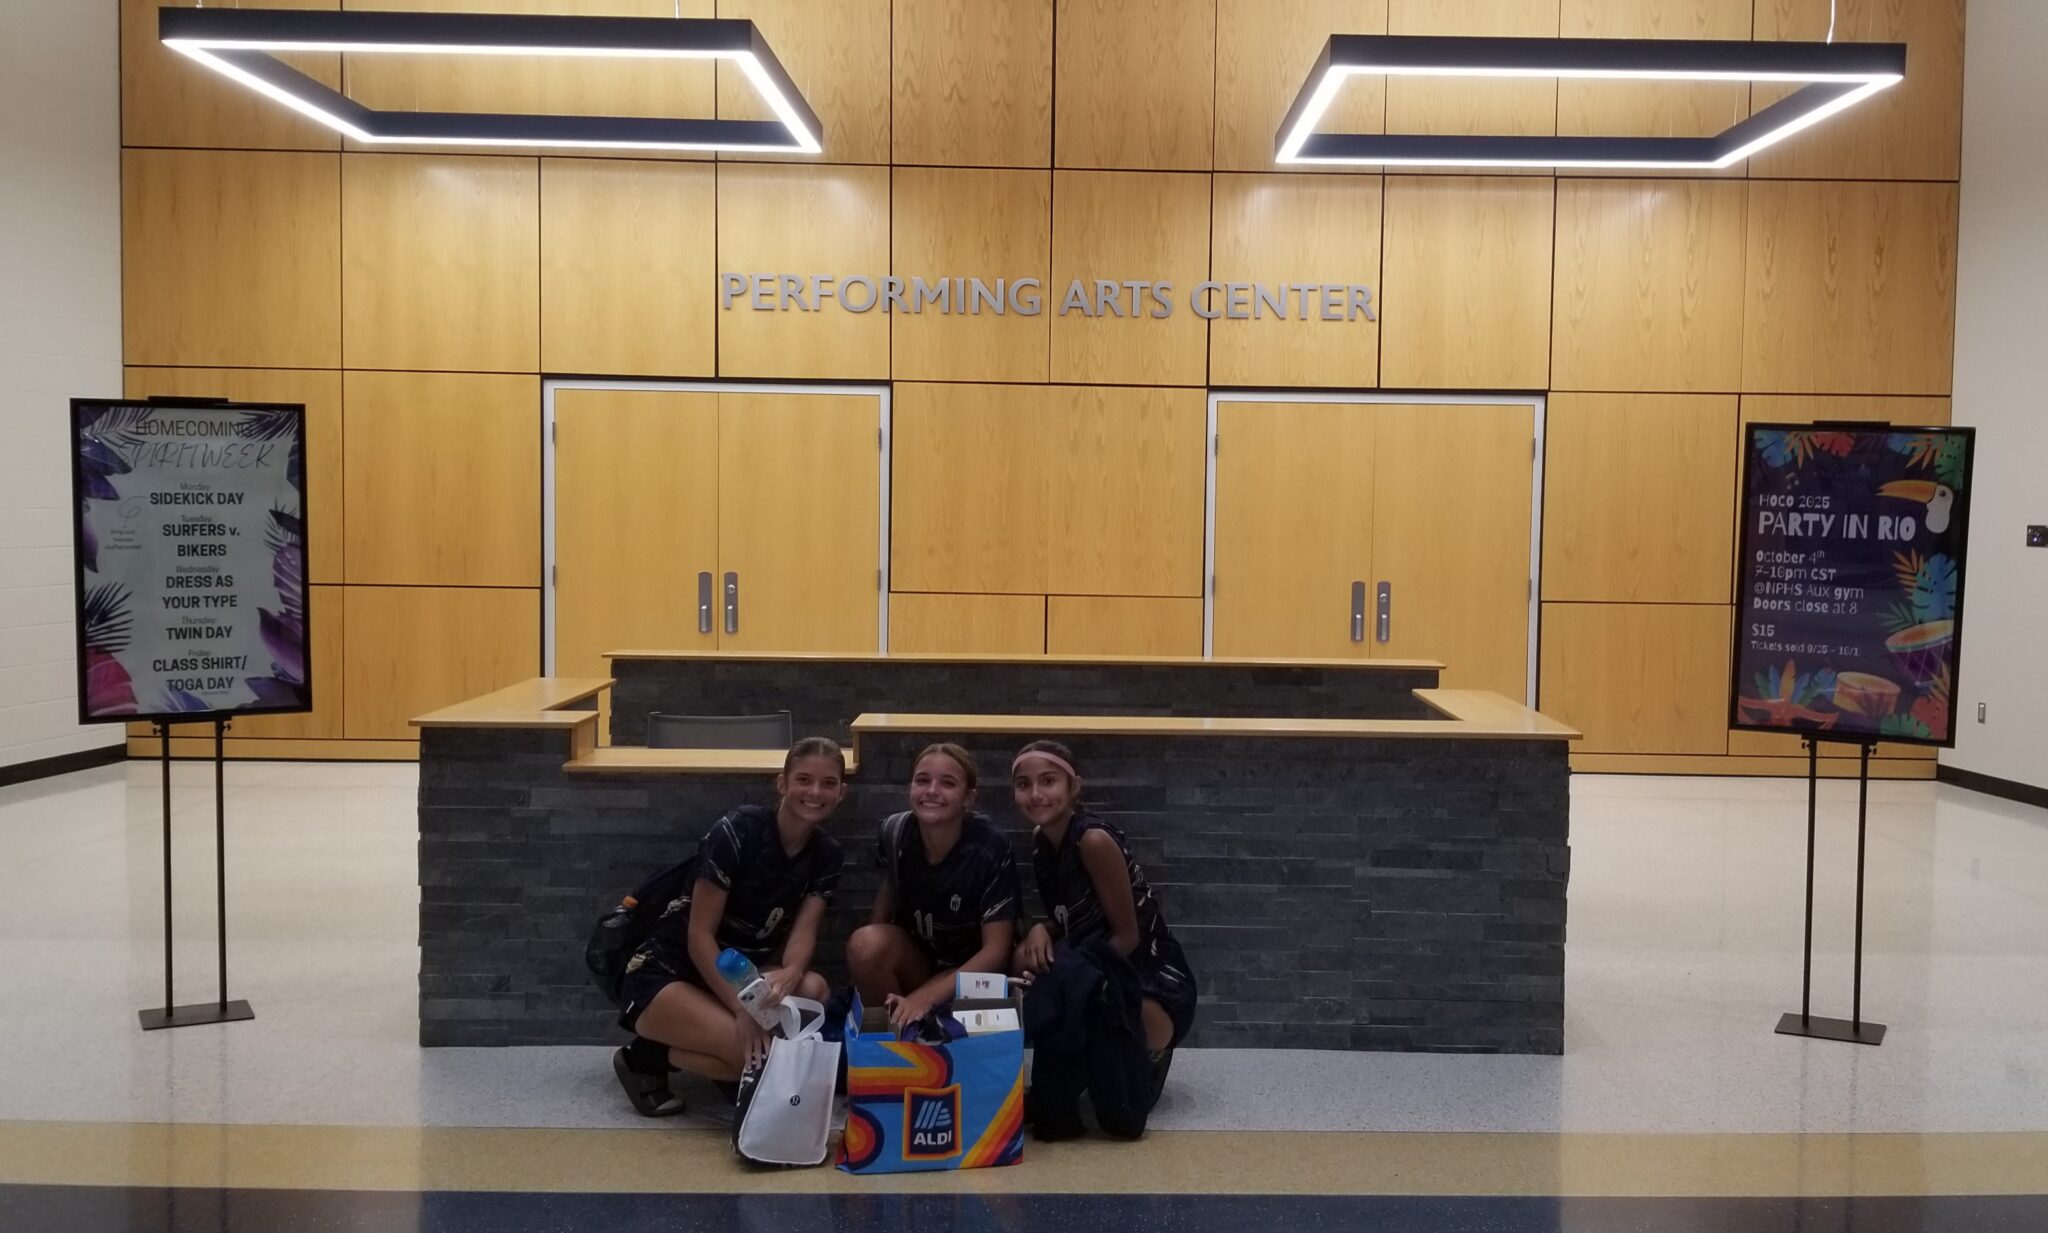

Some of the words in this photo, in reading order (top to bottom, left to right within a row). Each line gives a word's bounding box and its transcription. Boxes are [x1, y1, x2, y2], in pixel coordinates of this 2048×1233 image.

[721, 272, 1043, 315] PERFORMING
[1059, 279, 1174, 319] ARTS
[1190, 281, 1378, 322] CENTER
[136, 419, 252, 438] HOMECOMING
[150, 491, 214, 505] SIDEKICK
[217, 492, 245, 505] DAY
[1798, 495, 1831, 509] 2025
[162, 523, 226, 537] SURFERS
[229, 527, 240, 536] v.
[1758, 511, 1835, 538] PARTY
[1842, 514, 1868, 539] IN
[1877, 515, 1916, 541] RIO
[177, 544, 227, 557] BIKERS
[1756, 550, 1806, 563] October
[1808, 550, 1825, 565] 4th
[166, 576, 212, 588] DRESS
[215, 575, 233, 587] AS
[1811, 568, 1837, 581] CST
[1754, 581, 1803, 595] @NPHS
[1833, 586, 1864, 600] gym
[162, 596, 200, 609] YOUR
[203, 595, 238, 608] TYPE
[1753, 597, 1791, 611] Doors
[1794, 599, 1829, 613] close
[1832, 602, 1845, 614] at
[1849, 601, 1858, 615] 8
[166, 627, 202, 640] TWIN
[205, 626, 233, 639] DAY
[1751, 623, 1775, 638] $15
[1751, 640, 1783, 651] Tickets
[1785, 643, 1804, 653] sold
[153, 658, 198, 672] CLASS
[201, 655, 248, 671] SHIRT/
[166, 678, 204, 692] TOGA
[207, 676, 234, 690] DAY
[756, 907, 784, 939] 9
[914, 1130, 952, 1145] ALDI
